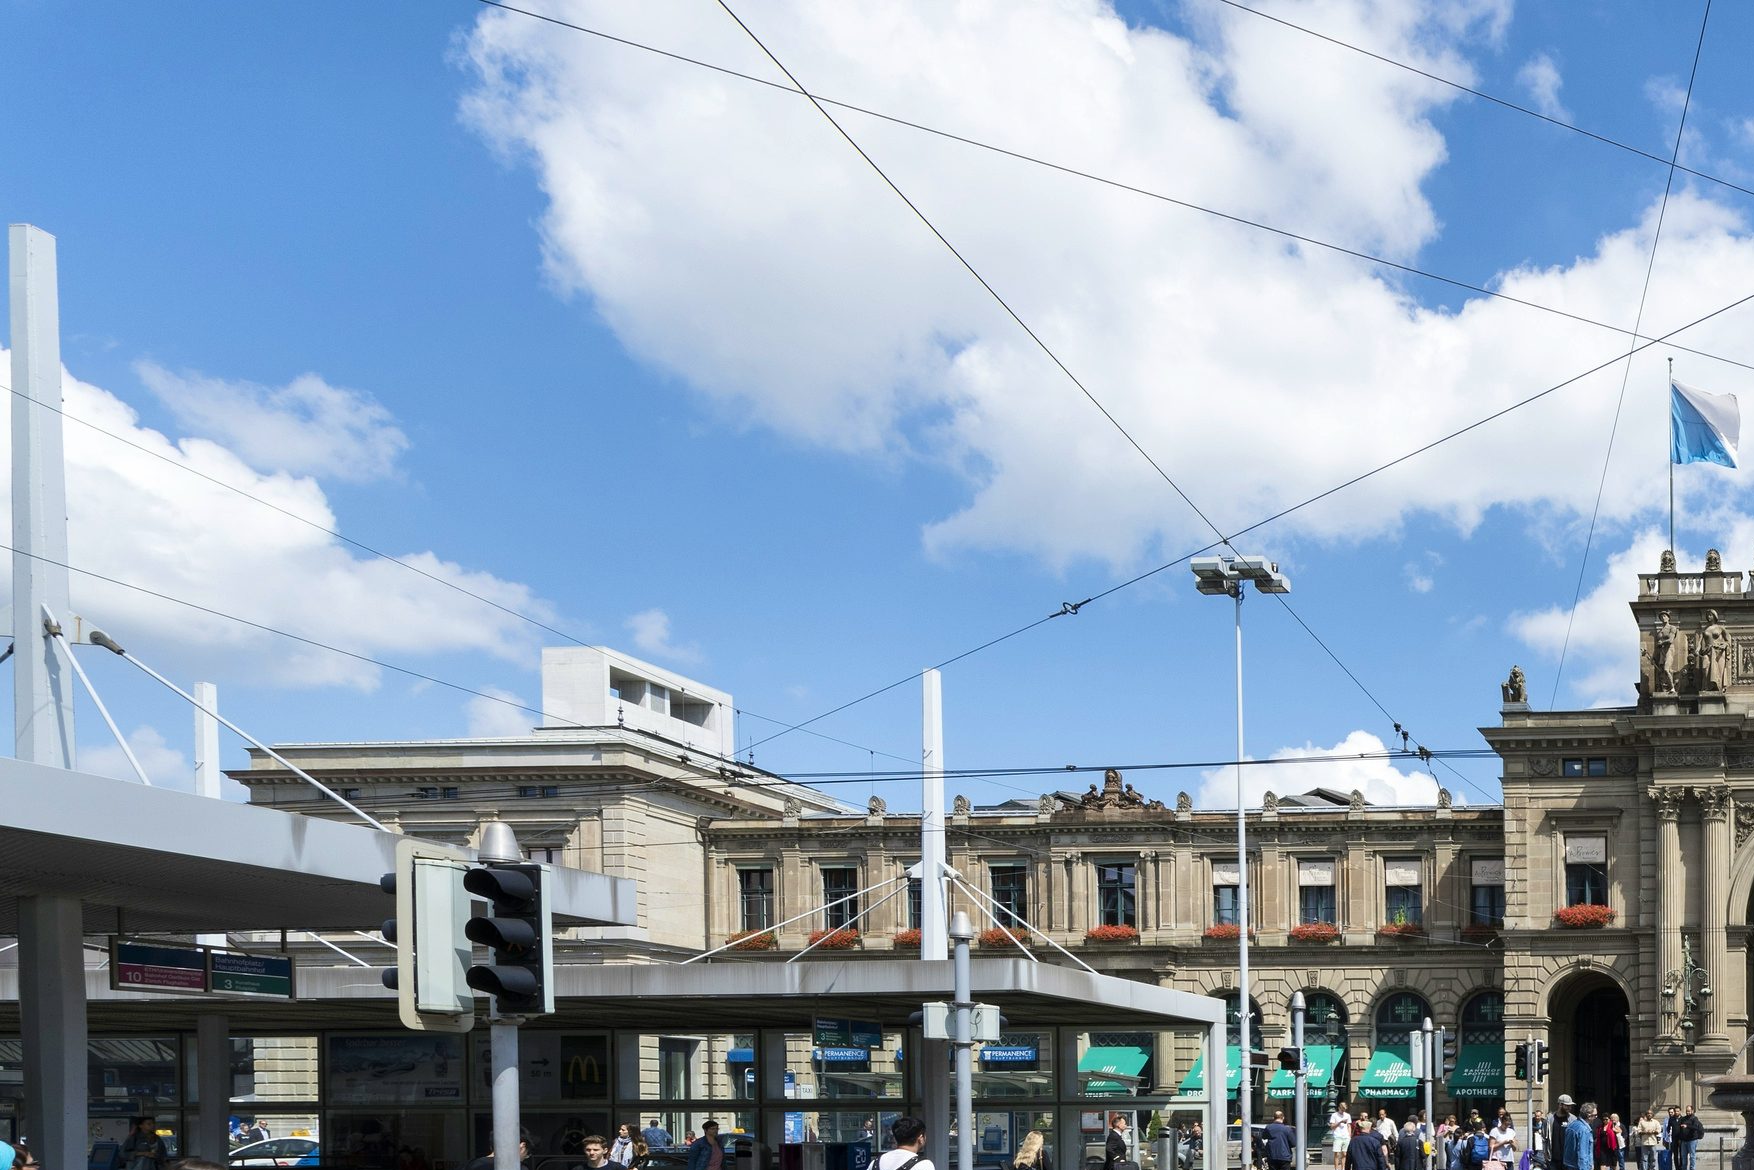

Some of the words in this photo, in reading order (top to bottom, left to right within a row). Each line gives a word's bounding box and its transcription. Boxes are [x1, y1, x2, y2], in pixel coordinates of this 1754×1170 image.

[215, 963, 266, 974] Hauptbahnhof
[126, 971, 142, 983] 10
[224, 979, 233, 990] 3
[1365, 1088, 1410, 1096] PHARMACY
[1455, 1088, 1498, 1096] APOTHEKE
